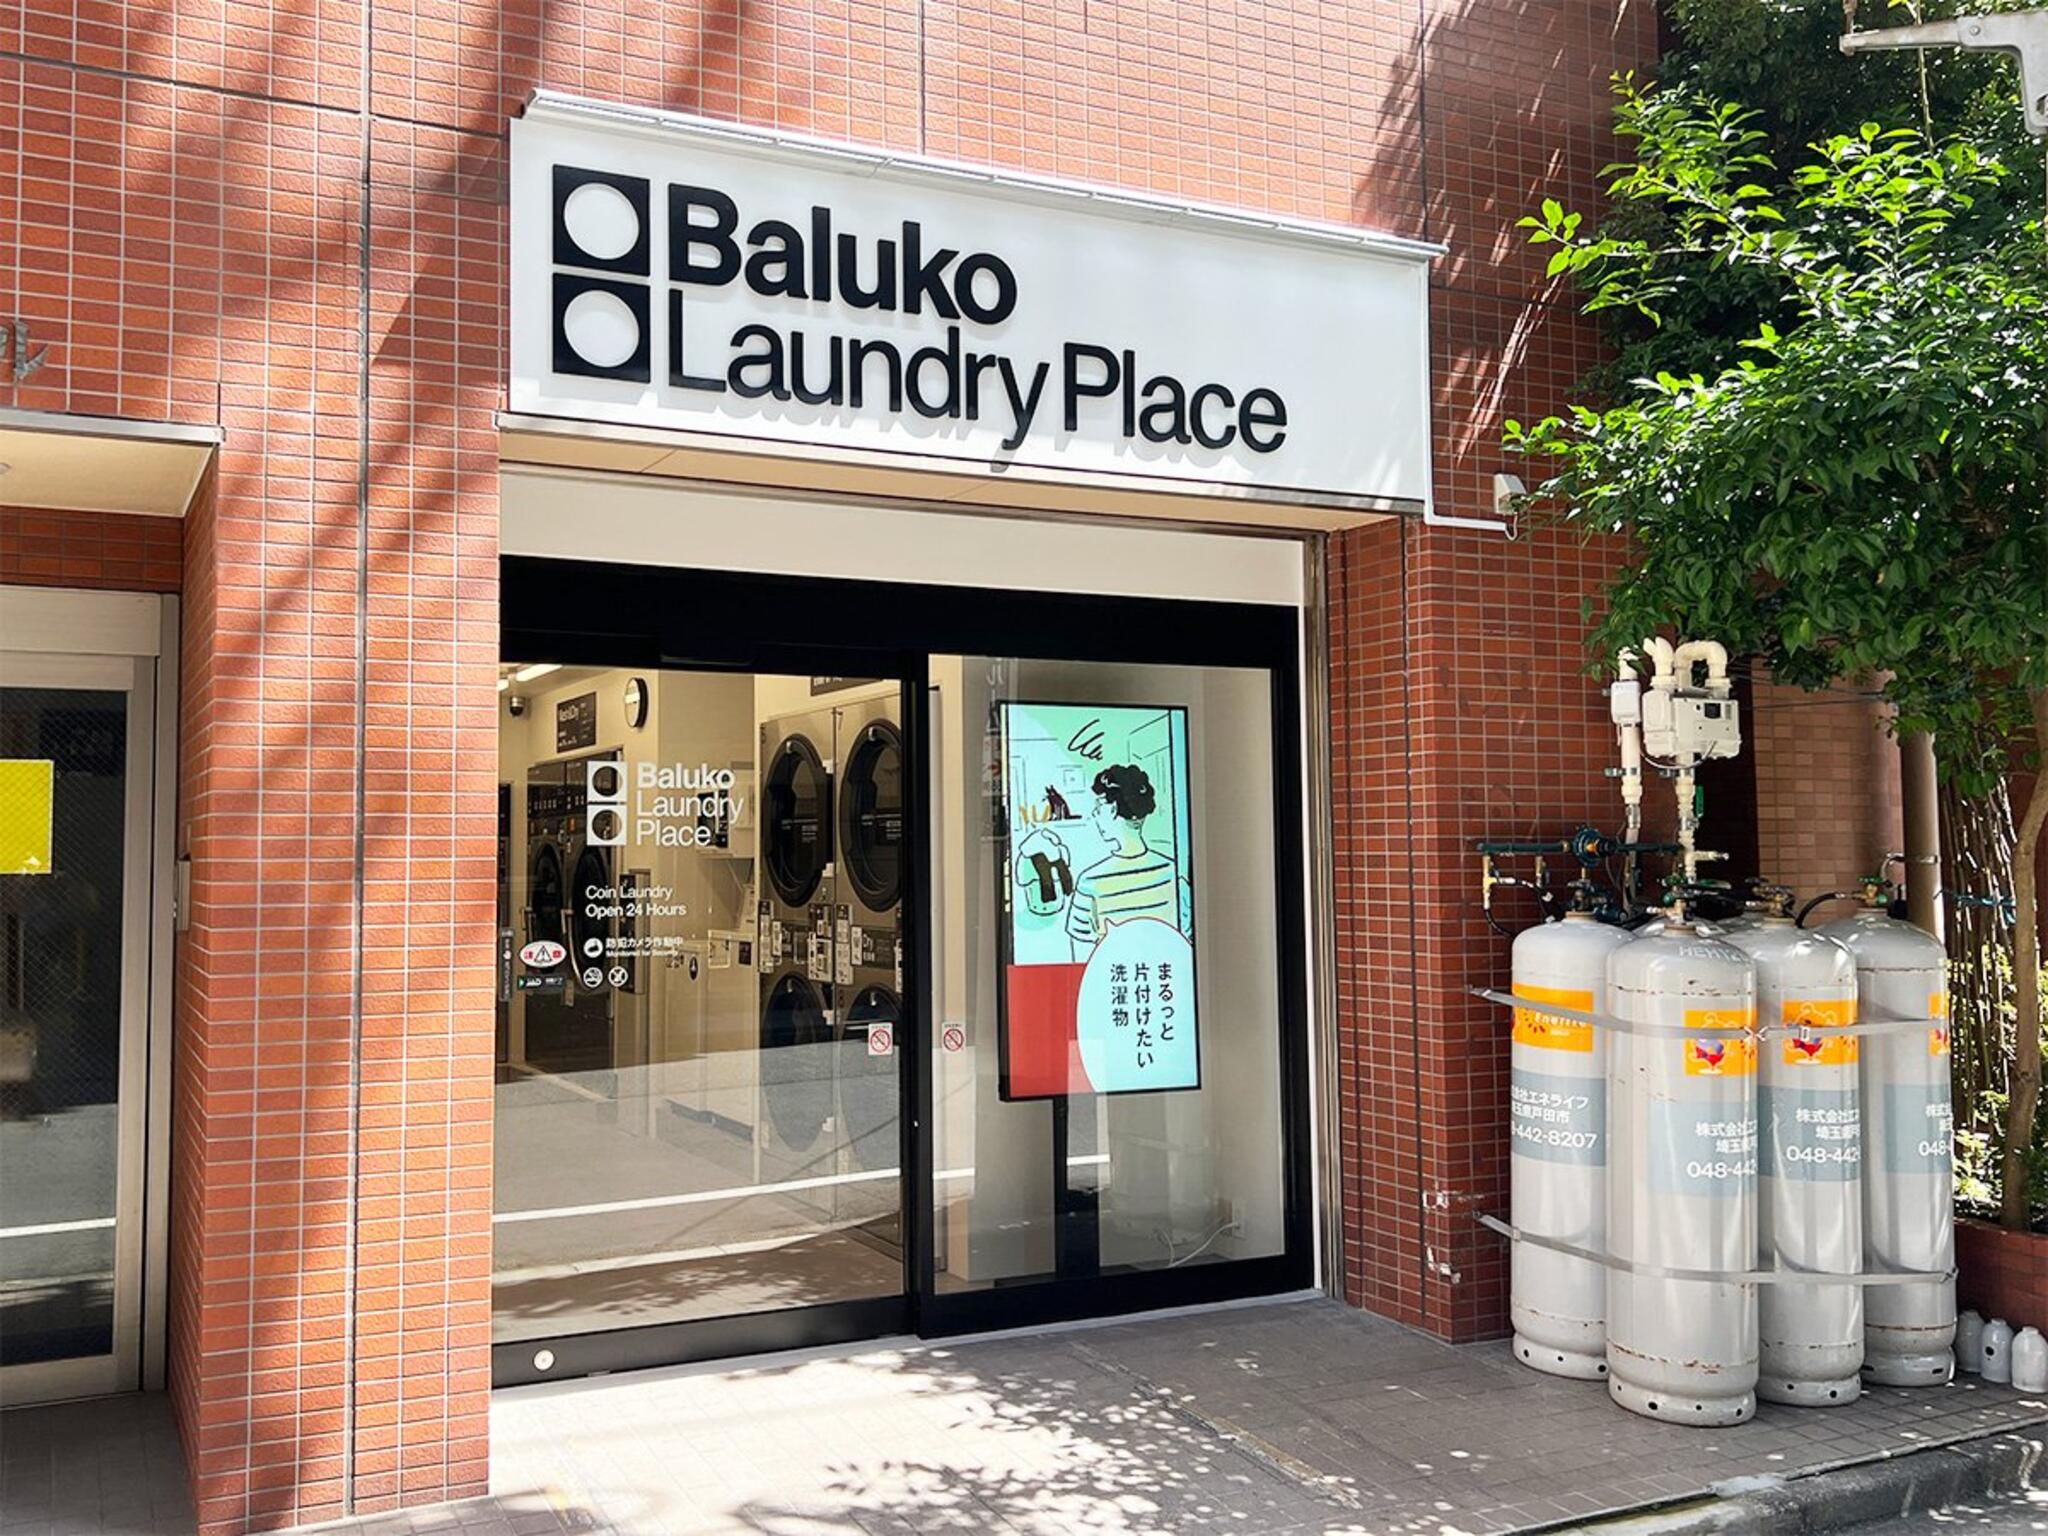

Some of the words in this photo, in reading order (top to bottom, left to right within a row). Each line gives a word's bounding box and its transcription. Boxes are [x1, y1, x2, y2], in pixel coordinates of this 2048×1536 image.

[668, 182, 1017, 325] Baluko
[669, 288, 1050, 450] Laundry
[1063, 342, 1288, 453] Place
[636, 761, 736, 789] Baluko
[636, 789, 745, 825] Laundry
[636, 818, 712, 847] Place
[585, 884, 618, 900] Coin
[620, 884, 673, 902] Laundry
[585, 903, 624, 920] Open
[625, 902, 643, 917] 24
[646, 902, 687, 916] Hours
[1110, 963, 1130, 1028] 洗濯物
[1134, 962, 1155, 1069] 片付けたい
[1157, 961, 1176, 1041] まるっと
